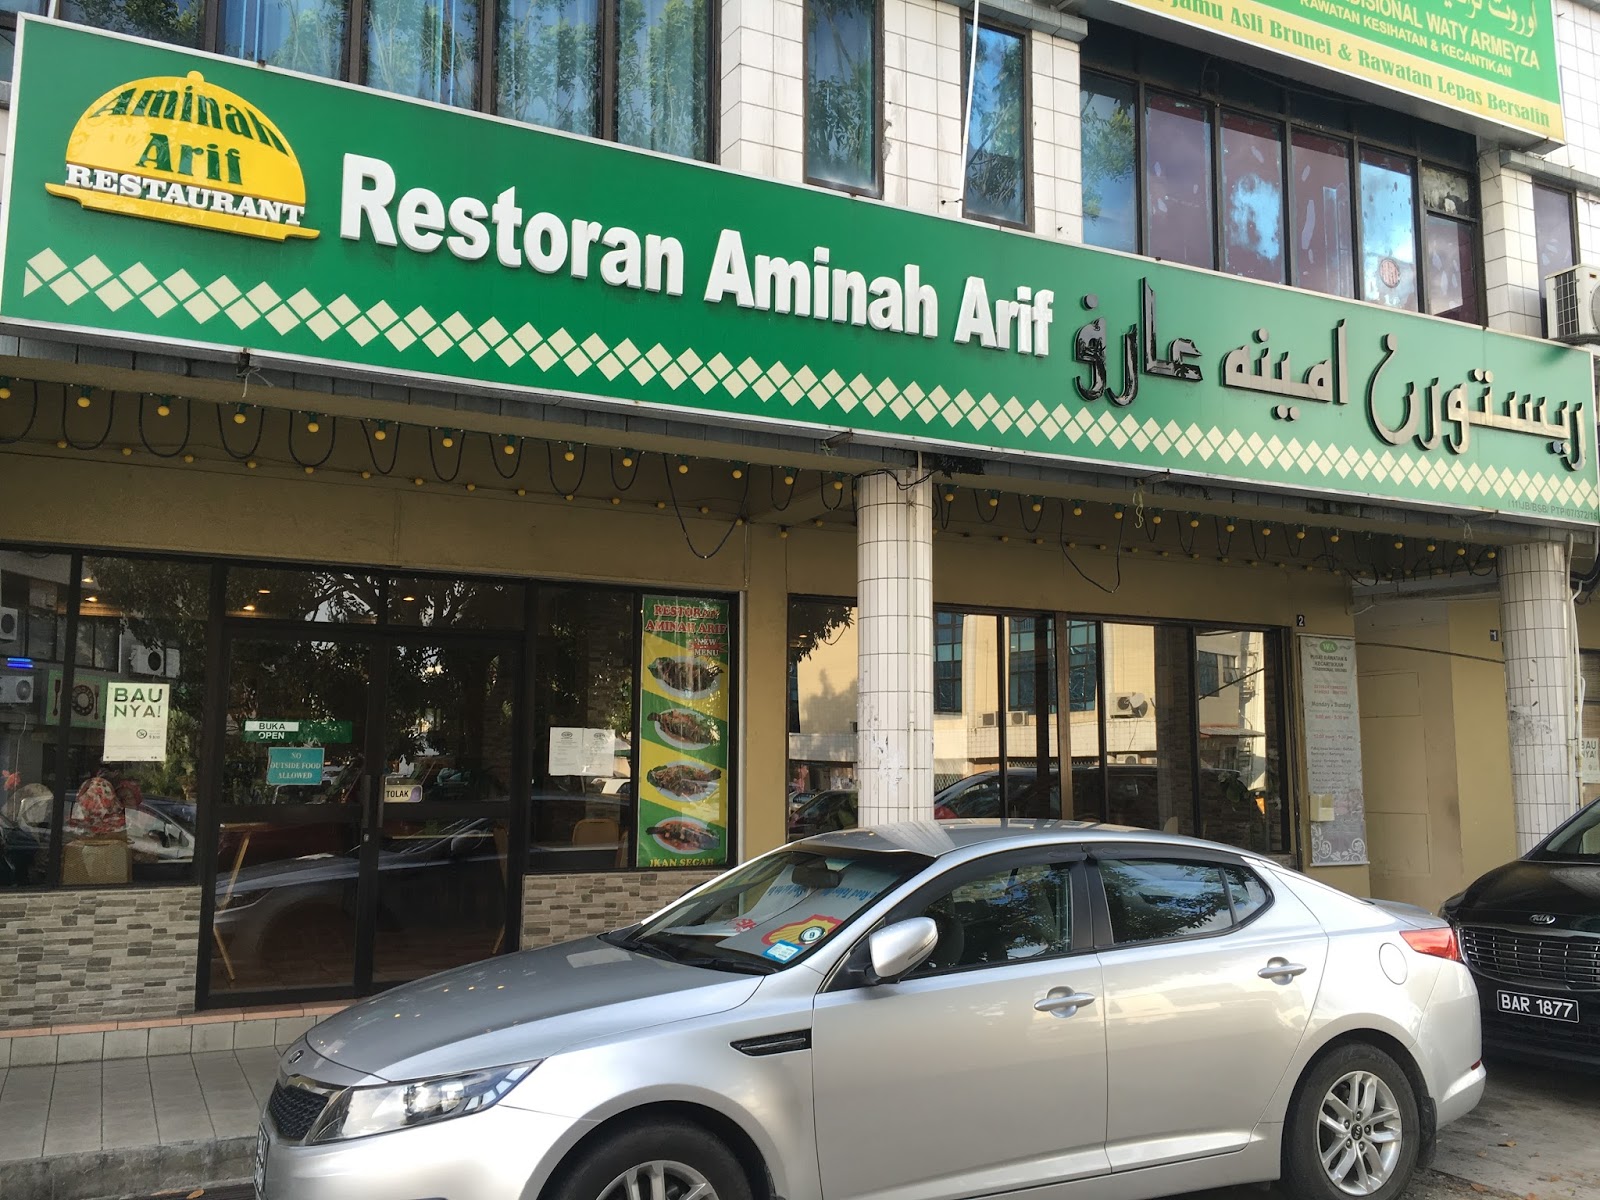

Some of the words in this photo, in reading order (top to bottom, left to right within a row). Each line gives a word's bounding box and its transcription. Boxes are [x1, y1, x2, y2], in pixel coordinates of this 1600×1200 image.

[1347, 0, 1423, 29] SIONAL
[1426, 11, 1468, 44] WATY
[1470, 29, 1540, 70] ARMEYZA
[1363, 17, 1428, 48] KESIHATAN
[1430, 39, 1439, 53] &
[1441, 42, 1513, 78] KECANTIKAN
[1230, 7, 1264, 34] Asli
[1269, 18, 1333, 56] Brunei
[1337, 42, 1352, 62] &
[1357, 49, 1433, 89] Rawatan
[1437, 75, 1483, 106] Lepas
[1487, 92, 1550, 128] Bersalin
[88, 85, 290, 158] Aminah
[135, 132, 243, 186] Arif
[64, 163, 305, 227] RESTAURANT
[339, 152, 684, 298] Restoran
[703, 228, 939, 339] Aminah
[953, 275, 1055, 357] Arif
[653, 604, 720, 619] RESTORAN
[645, 619, 696, 633] AMINAH
[698, 622, 727, 634] ARIF
[1298, 615, 1304, 626] 2
[697, 638, 717, 646] NEW
[694, 649, 719, 657] MENU
[113, 687, 163, 703] BAU
[113, 704, 161, 718] NYA!
[258, 722, 286, 730] BUKA
[258, 731, 285, 740] OPEN
[1581, 740, 1597, 750] BAU
[270, 761, 300, 769] OUTSIDE
[278, 771, 313, 779] ALLOWED
[386, 790, 409, 798] TOLAK
[649, 857, 678, 867] IKAN
[679, 857, 714, 867] SEGAR
[1501, 993, 1530, 1013] BAR
[1536, 999, 1574, 1018] 1877
